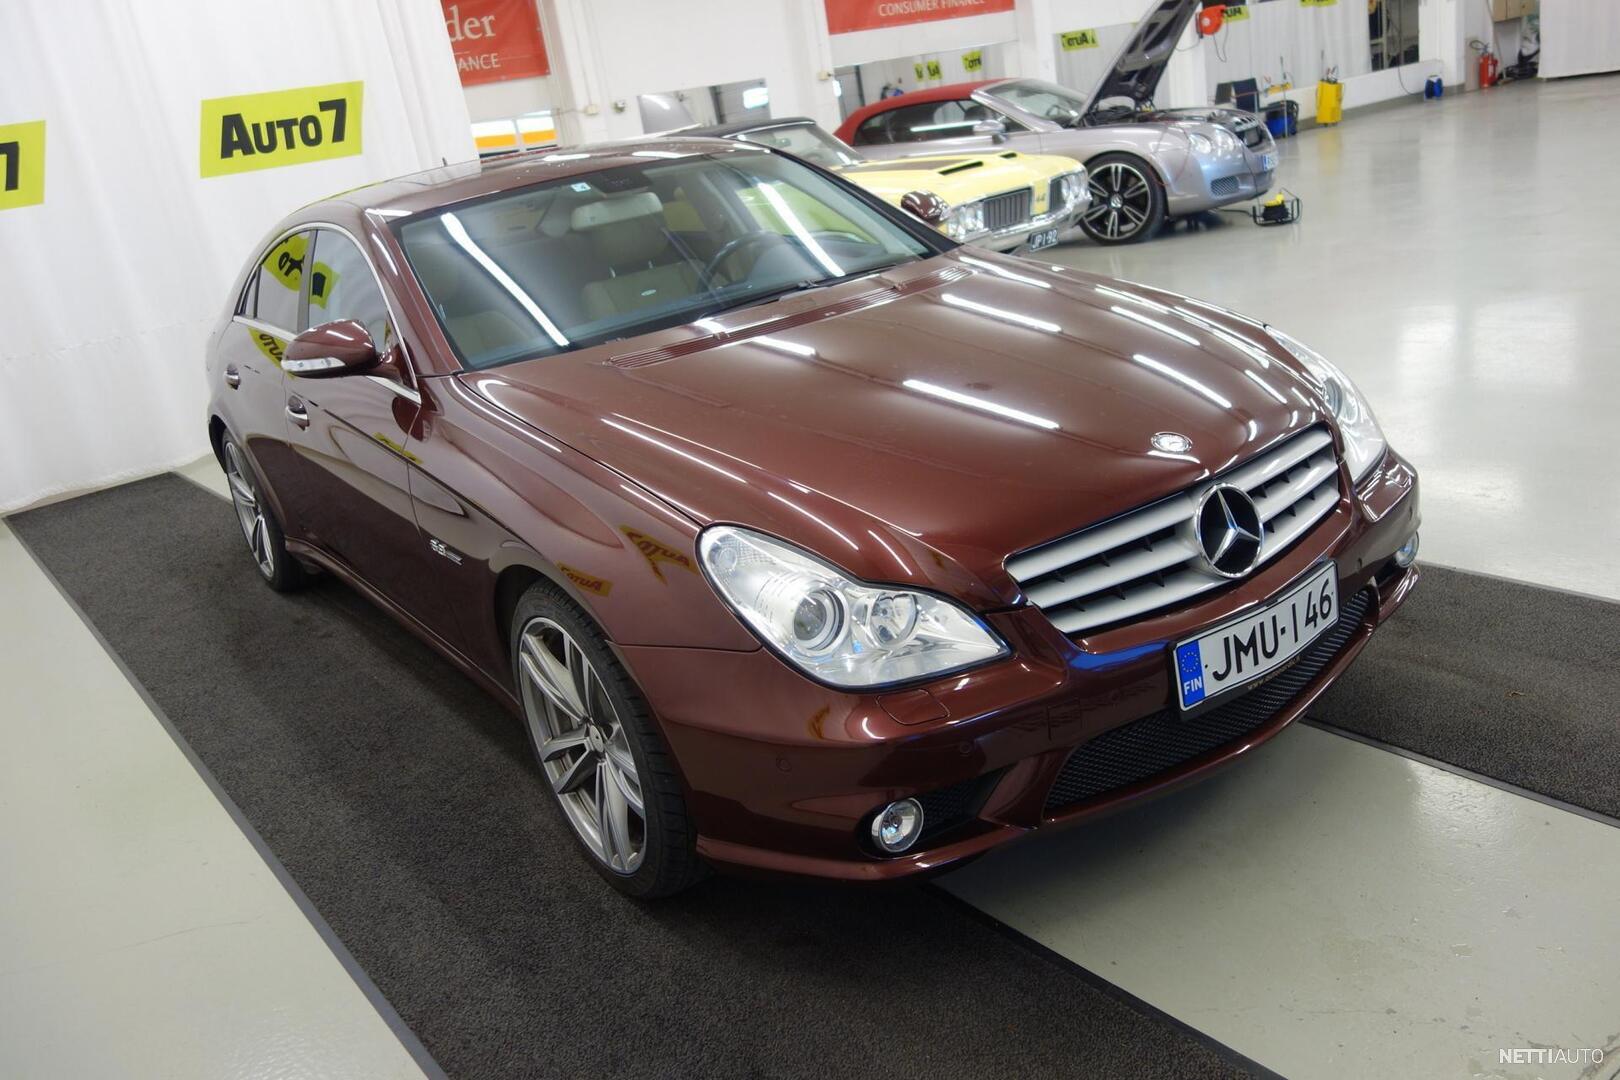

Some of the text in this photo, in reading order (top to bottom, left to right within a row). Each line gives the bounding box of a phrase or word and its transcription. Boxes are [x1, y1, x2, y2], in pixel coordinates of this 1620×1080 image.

[879, 0, 939, 16] CONSUMER
[1212, 578, 1333, 681] JMU-146
[1183, 676, 1203, 696] FIN
